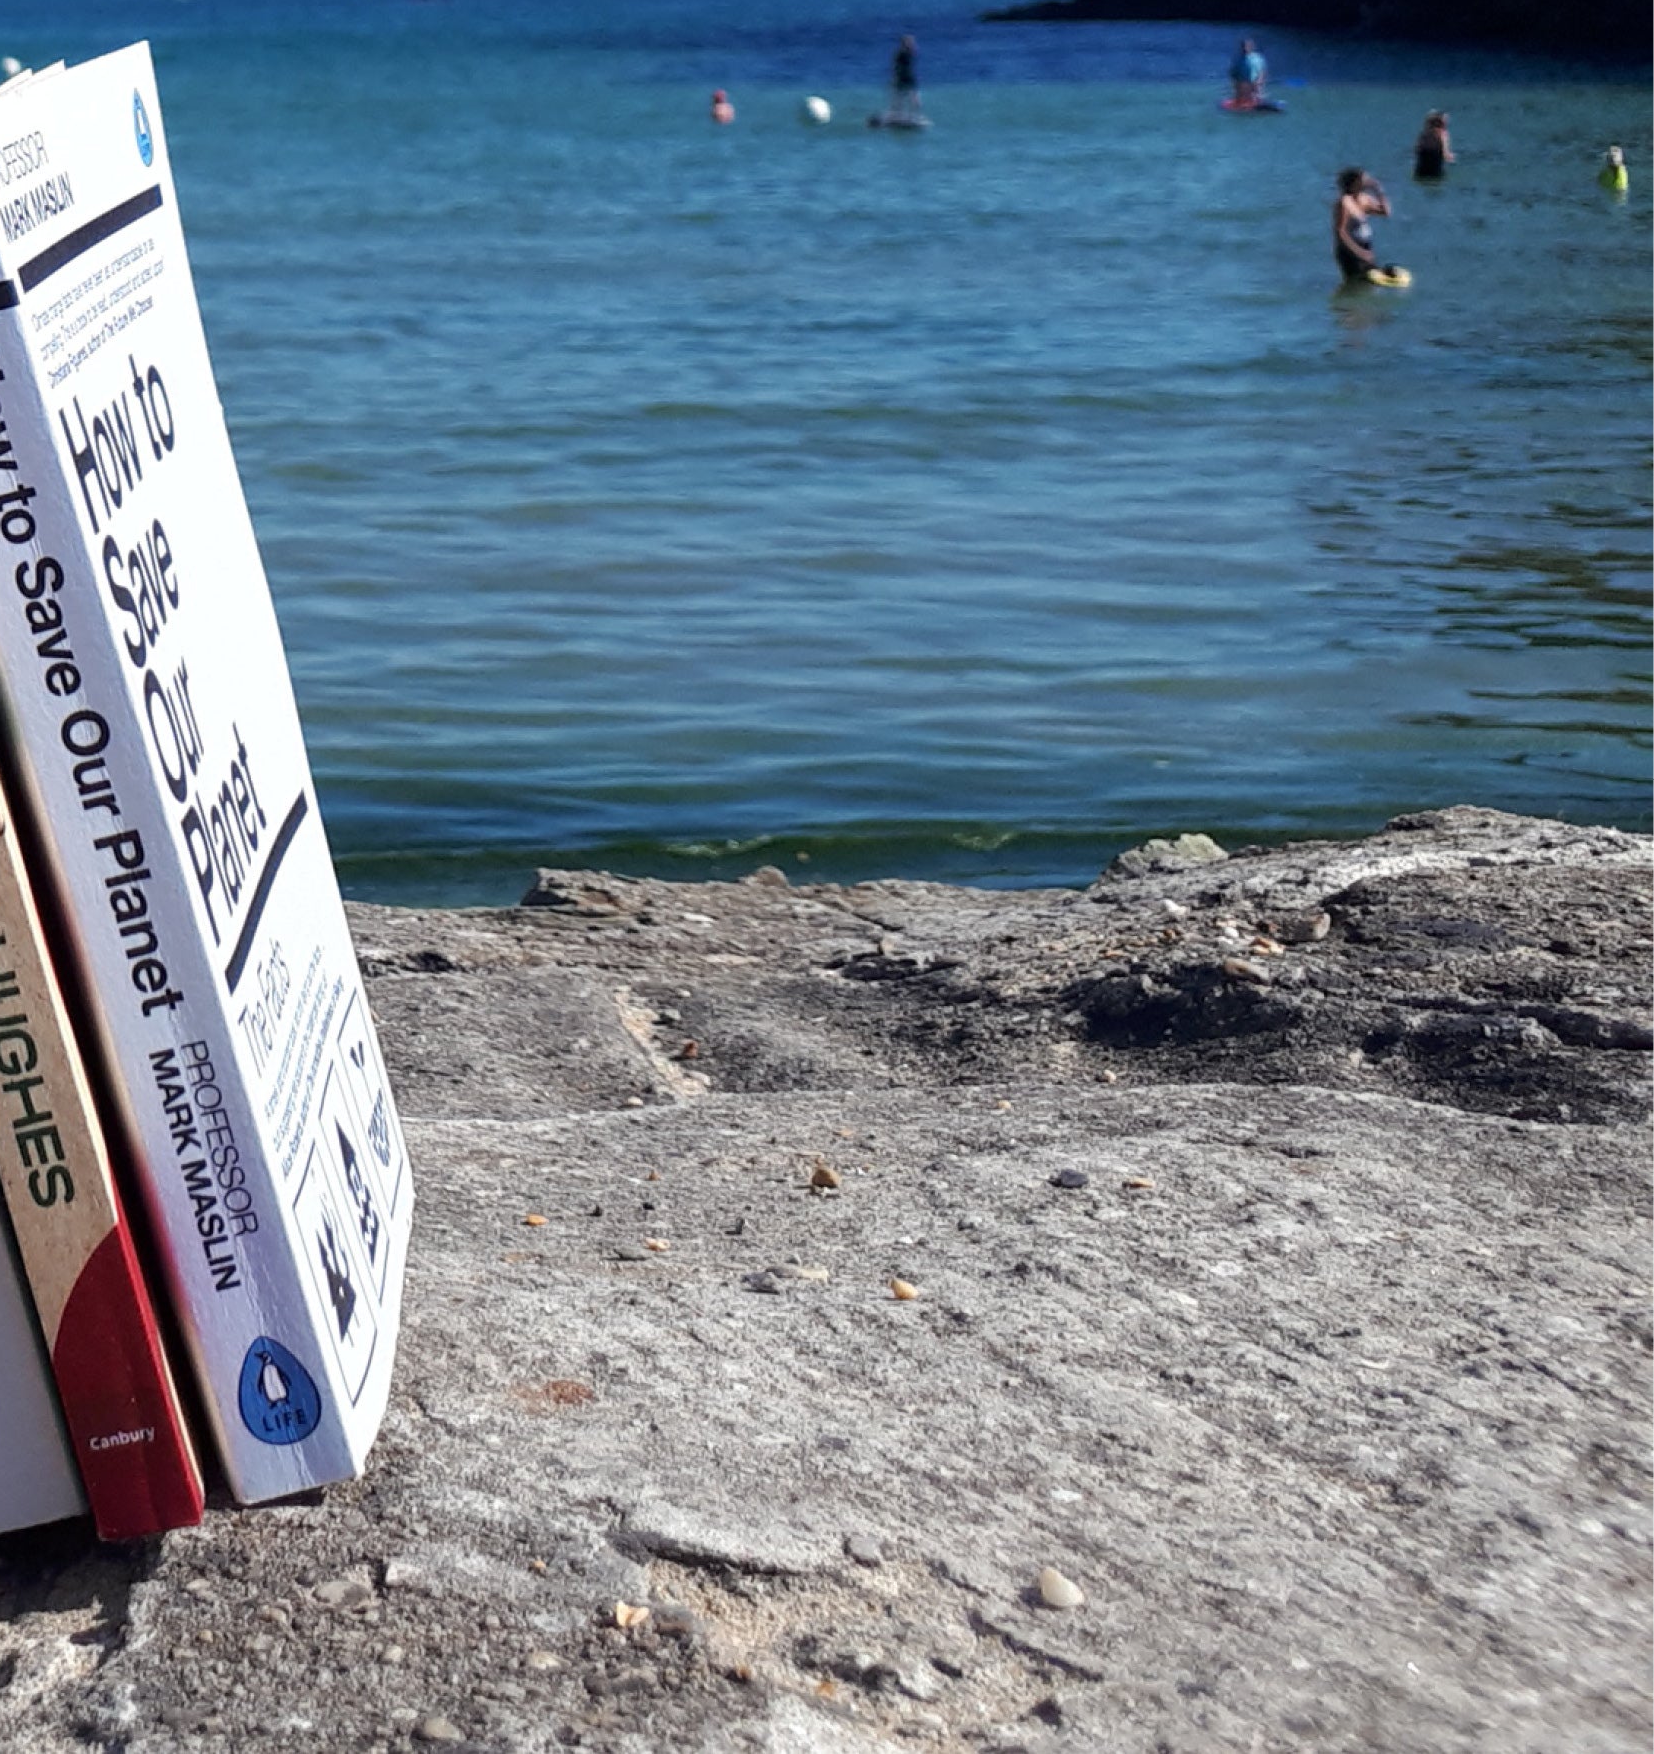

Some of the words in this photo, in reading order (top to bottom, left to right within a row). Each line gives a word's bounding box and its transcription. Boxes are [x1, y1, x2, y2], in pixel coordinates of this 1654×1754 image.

[33, 171, 75, 227] MASLIN
[59, 391, 143, 535] How
[129, 353, 175, 463] to
[103, 517, 180, 669] Save
[15, 555, 82, 698] Save
[61, 708, 121, 817] Our
[94, 830, 184, 1017] Planet
[144, 656, 205, 805] Our
[181, 721, 267, 947] Planet
[238, 1000, 273, 1079] The
[256, 937, 291, 1036] Facts
[149, 1048, 203, 1155] MARK
[180, 1146, 242, 1292] MASLIN
[183, 1040, 260, 1237] PROFESSOR
[89, 1426, 155, 1451] Canbury
[262, 1407, 306, 1433] LIFE
